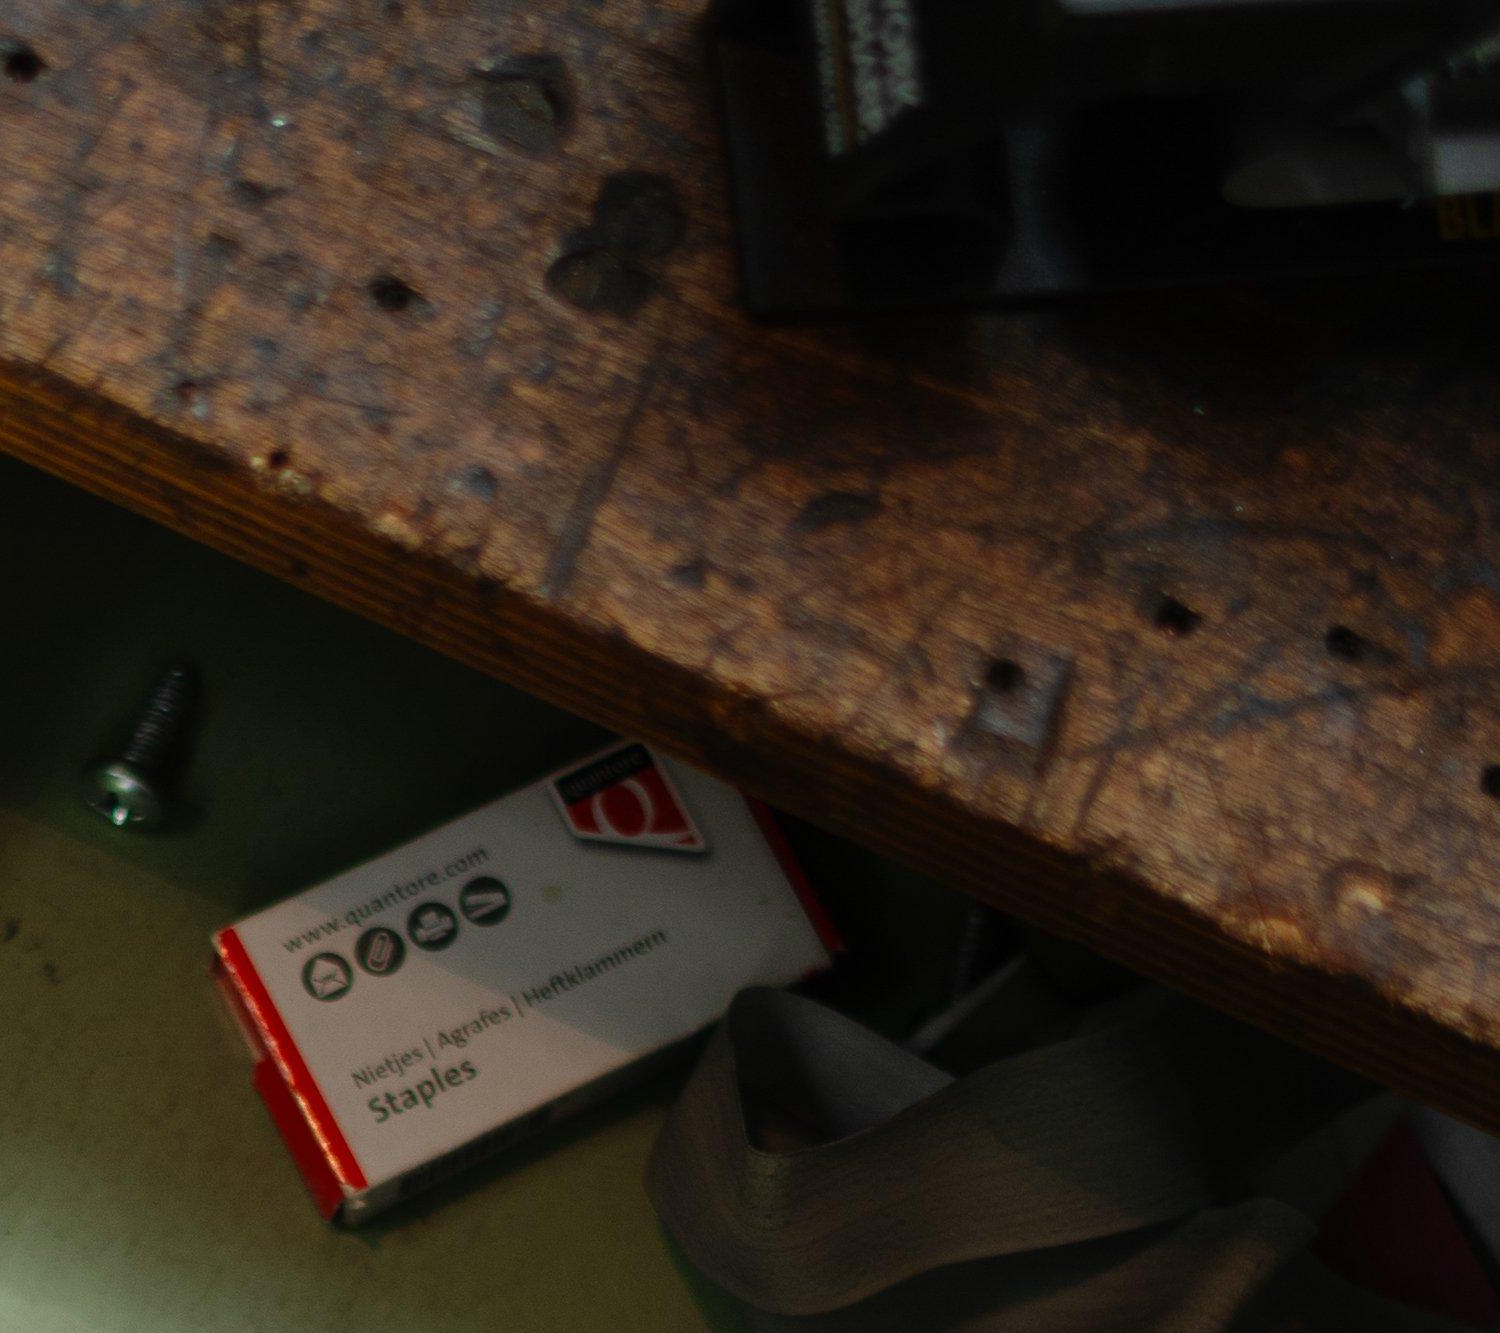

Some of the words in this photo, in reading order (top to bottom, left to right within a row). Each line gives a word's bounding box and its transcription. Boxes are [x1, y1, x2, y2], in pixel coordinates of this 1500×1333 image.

[283, 846, 489, 954] www.quantore.com
[351, 1048, 422, 1090] Nietjes
[436, 1004, 511, 1049] Agrafes
[524, 928, 668, 1007] Heftklammern
[368, 1058, 479, 1125] Staples
